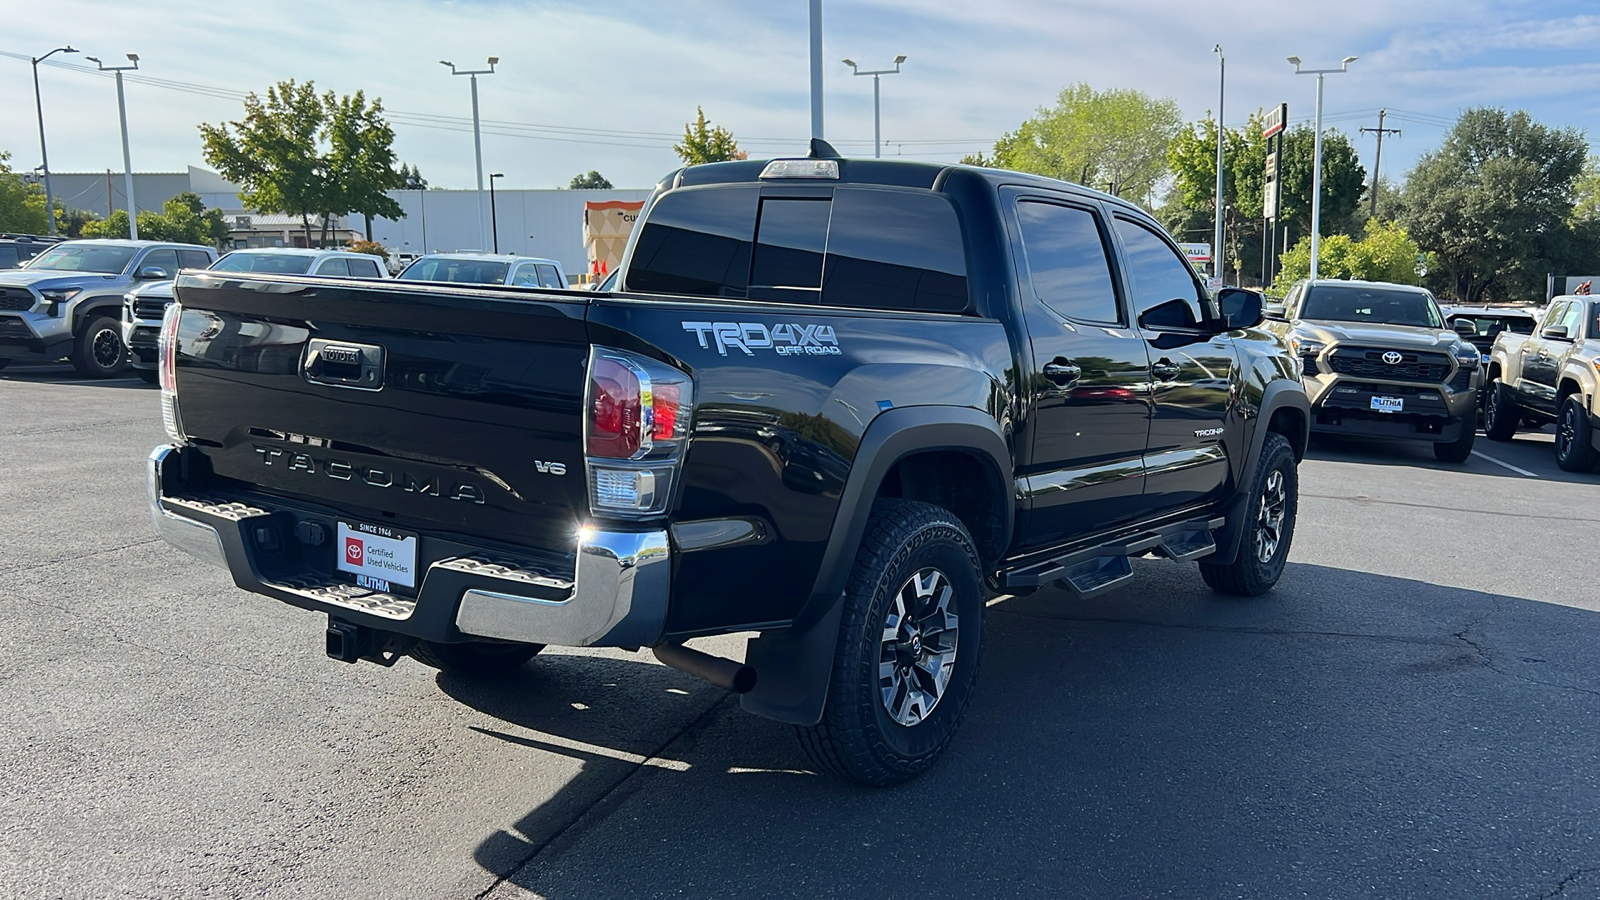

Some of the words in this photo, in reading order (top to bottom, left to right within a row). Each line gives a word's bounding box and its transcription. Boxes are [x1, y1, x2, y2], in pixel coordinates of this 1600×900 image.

[623, 214, 638, 223] CU
[325, 349, 357, 362] TOYOTA
[775, 345, 804, 356] OFF
[804, 346, 842, 355] ROAD
[1379, 399, 1401, 407] LITHIA
[534, 460, 567, 476] V6
[253, 446, 486, 504] TACOMA
[359, 523, 378, 534] SINCE
[378, 527, 392, 537] 1946
[367, 546, 394, 559] Certified
[367, 557, 383, 568] Used
[384, 561, 409, 573] Vehicles
[364, 576, 390, 593] LITHIA
